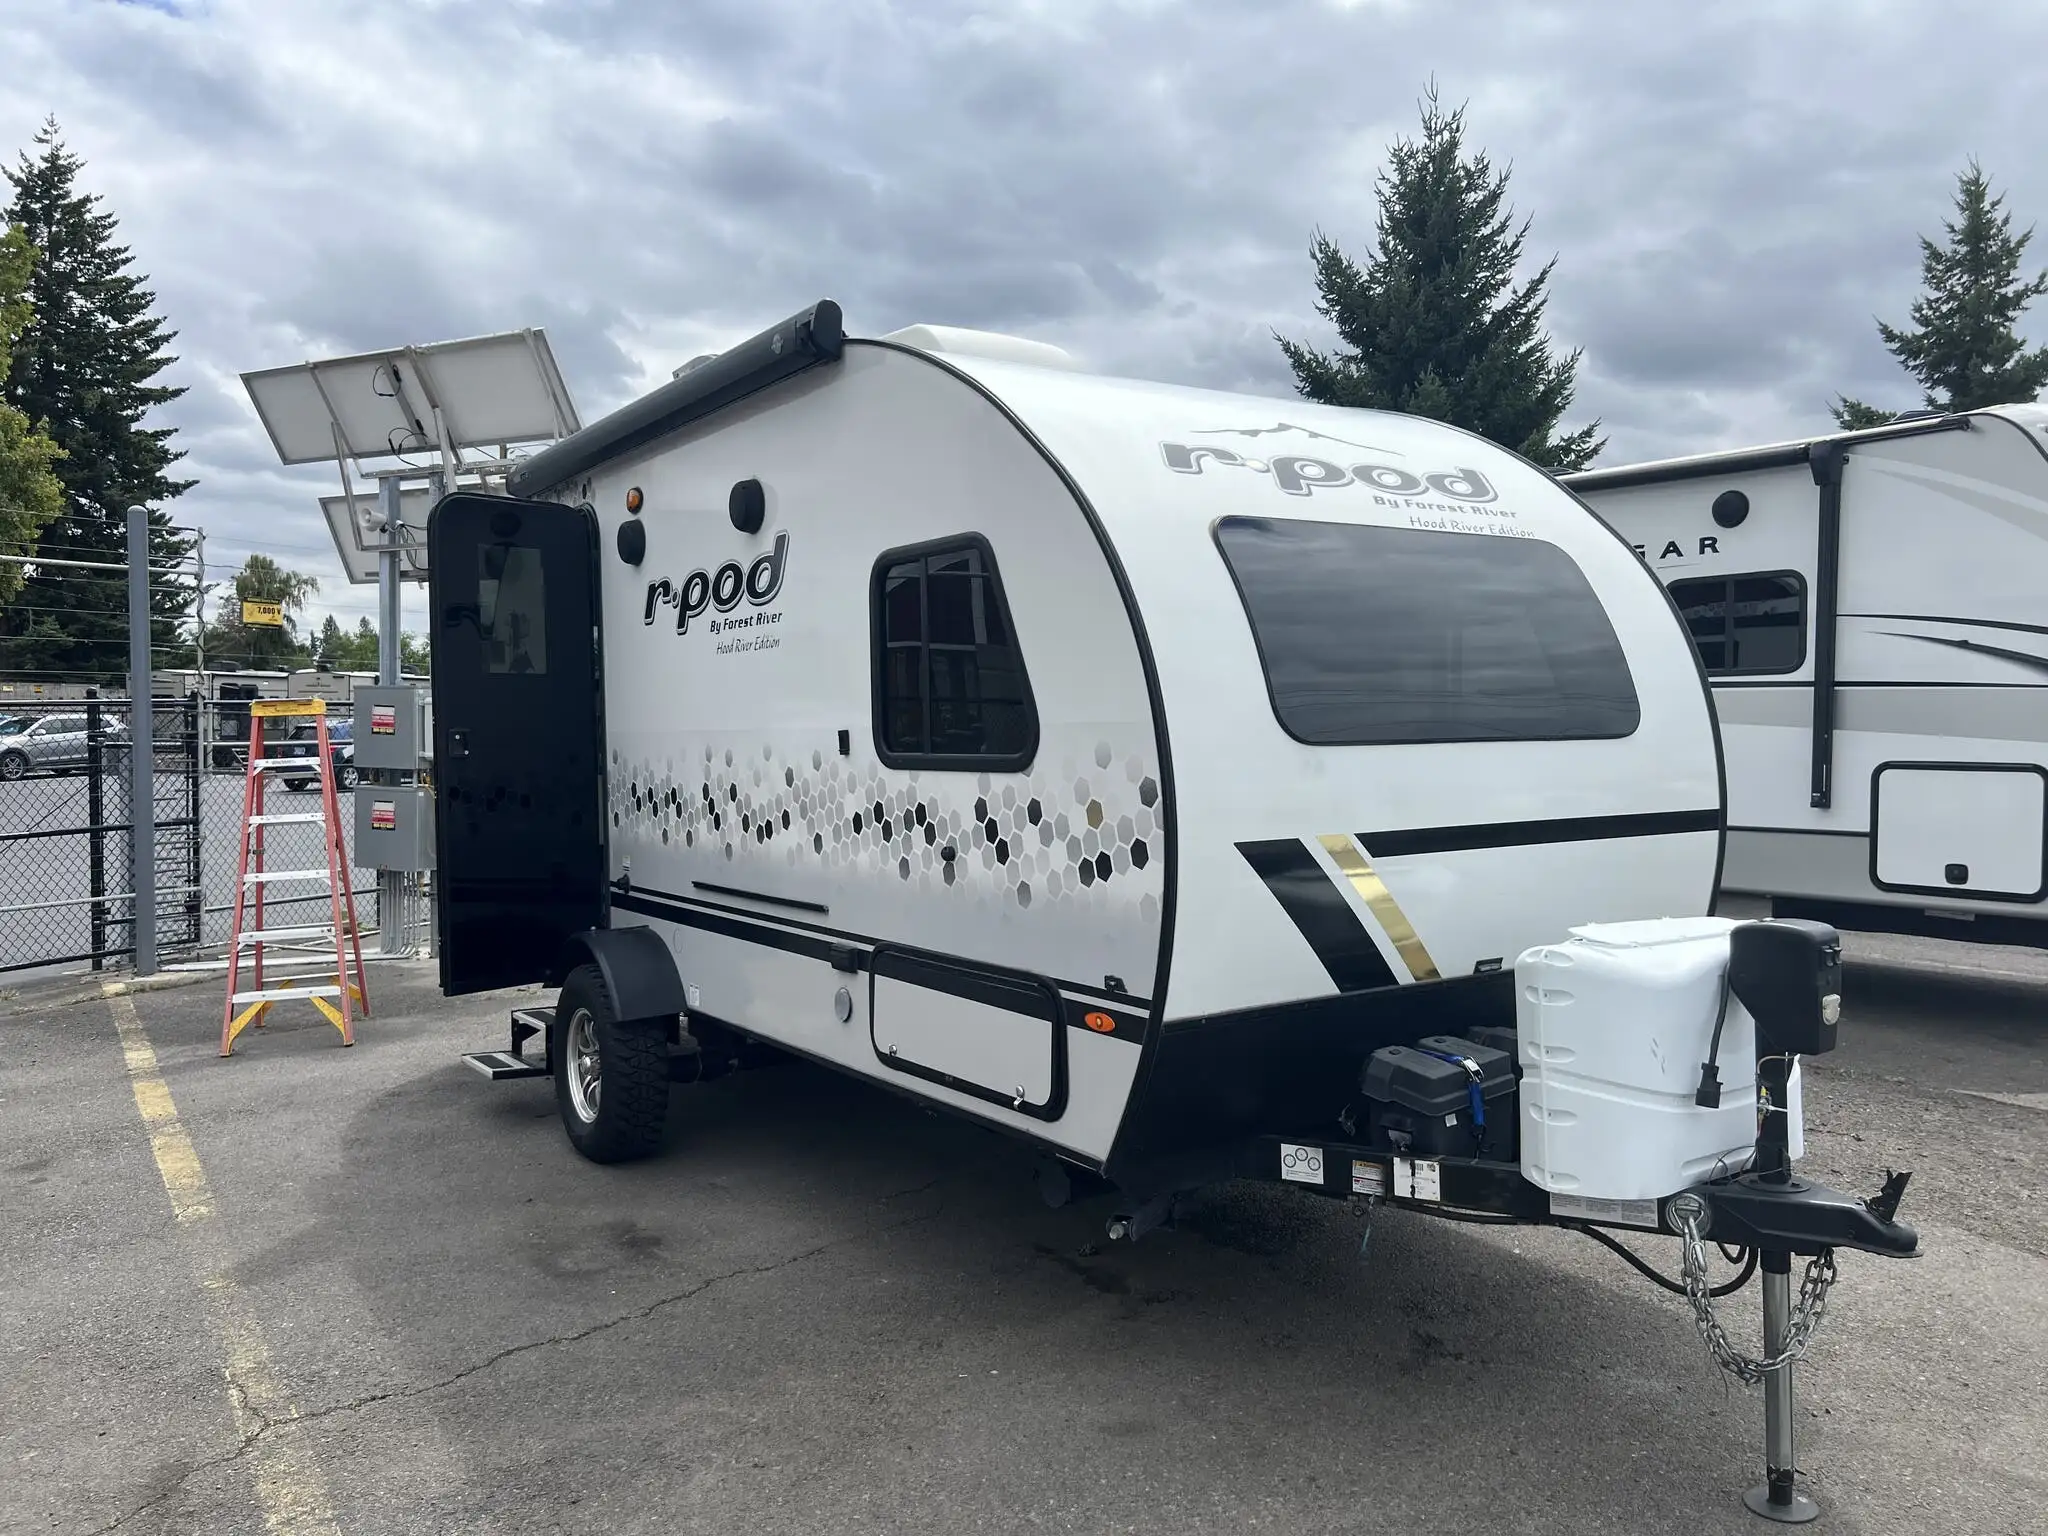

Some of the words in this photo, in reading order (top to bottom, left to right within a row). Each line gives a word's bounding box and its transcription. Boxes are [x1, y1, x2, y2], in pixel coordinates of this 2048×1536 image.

[1372, 495, 1400, 509] By
[1404, 499, 1469, 515] Forest
[1470, 505, 1518, 519] River
[1409, 515, 1447, 530] Hood
[1451, 519, 1485, 533] River
[1489, 523, 1536, 538] Edition
[710, 620, 722, 635] By
[723, 615, 754, 630] Forest
[756, 612, 783, 626] River
[716, 637, 735, 654] Hood
[735, 638, 754, 653] River
[754, 633, 780, 651] Edition
